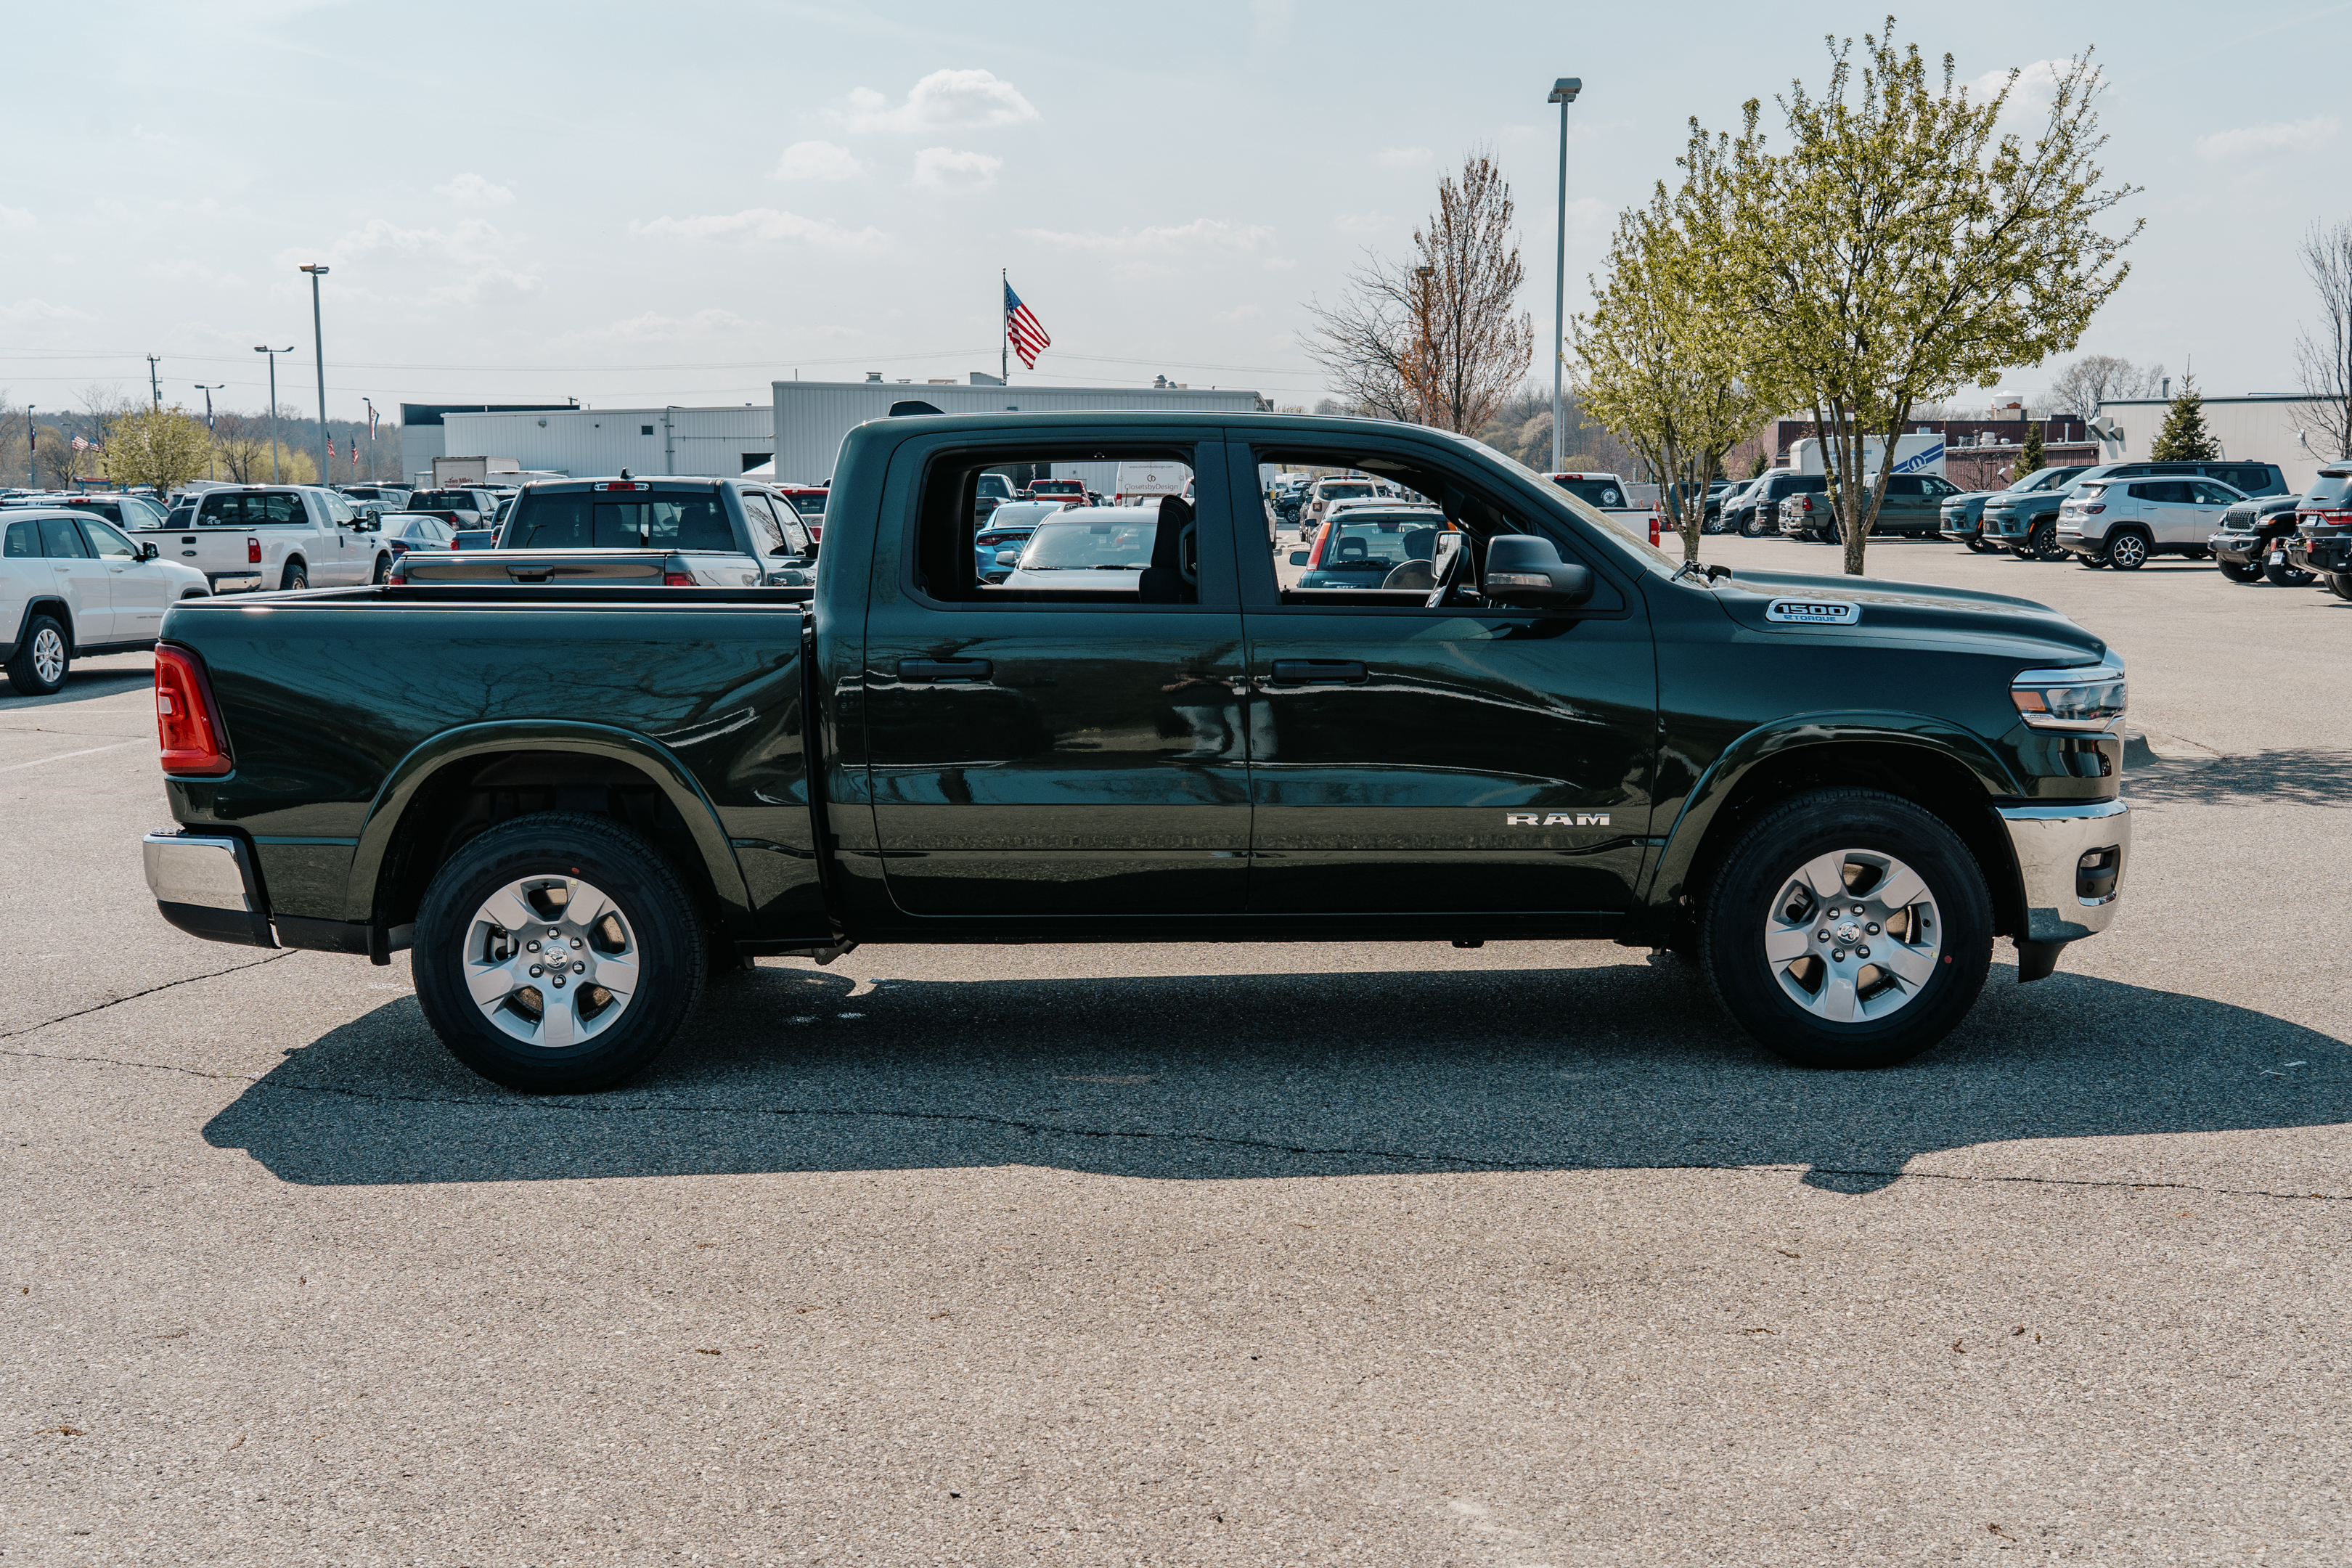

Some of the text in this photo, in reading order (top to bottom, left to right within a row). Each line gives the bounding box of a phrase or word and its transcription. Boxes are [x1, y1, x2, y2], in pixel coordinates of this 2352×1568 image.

[1779, 604, 1847, 616] 1500
[1506, 812, 1610, 825] RAM
[444, 848, 604, 919] WRANGLER
[1748, 823, 1905, 905] WRANGLER
